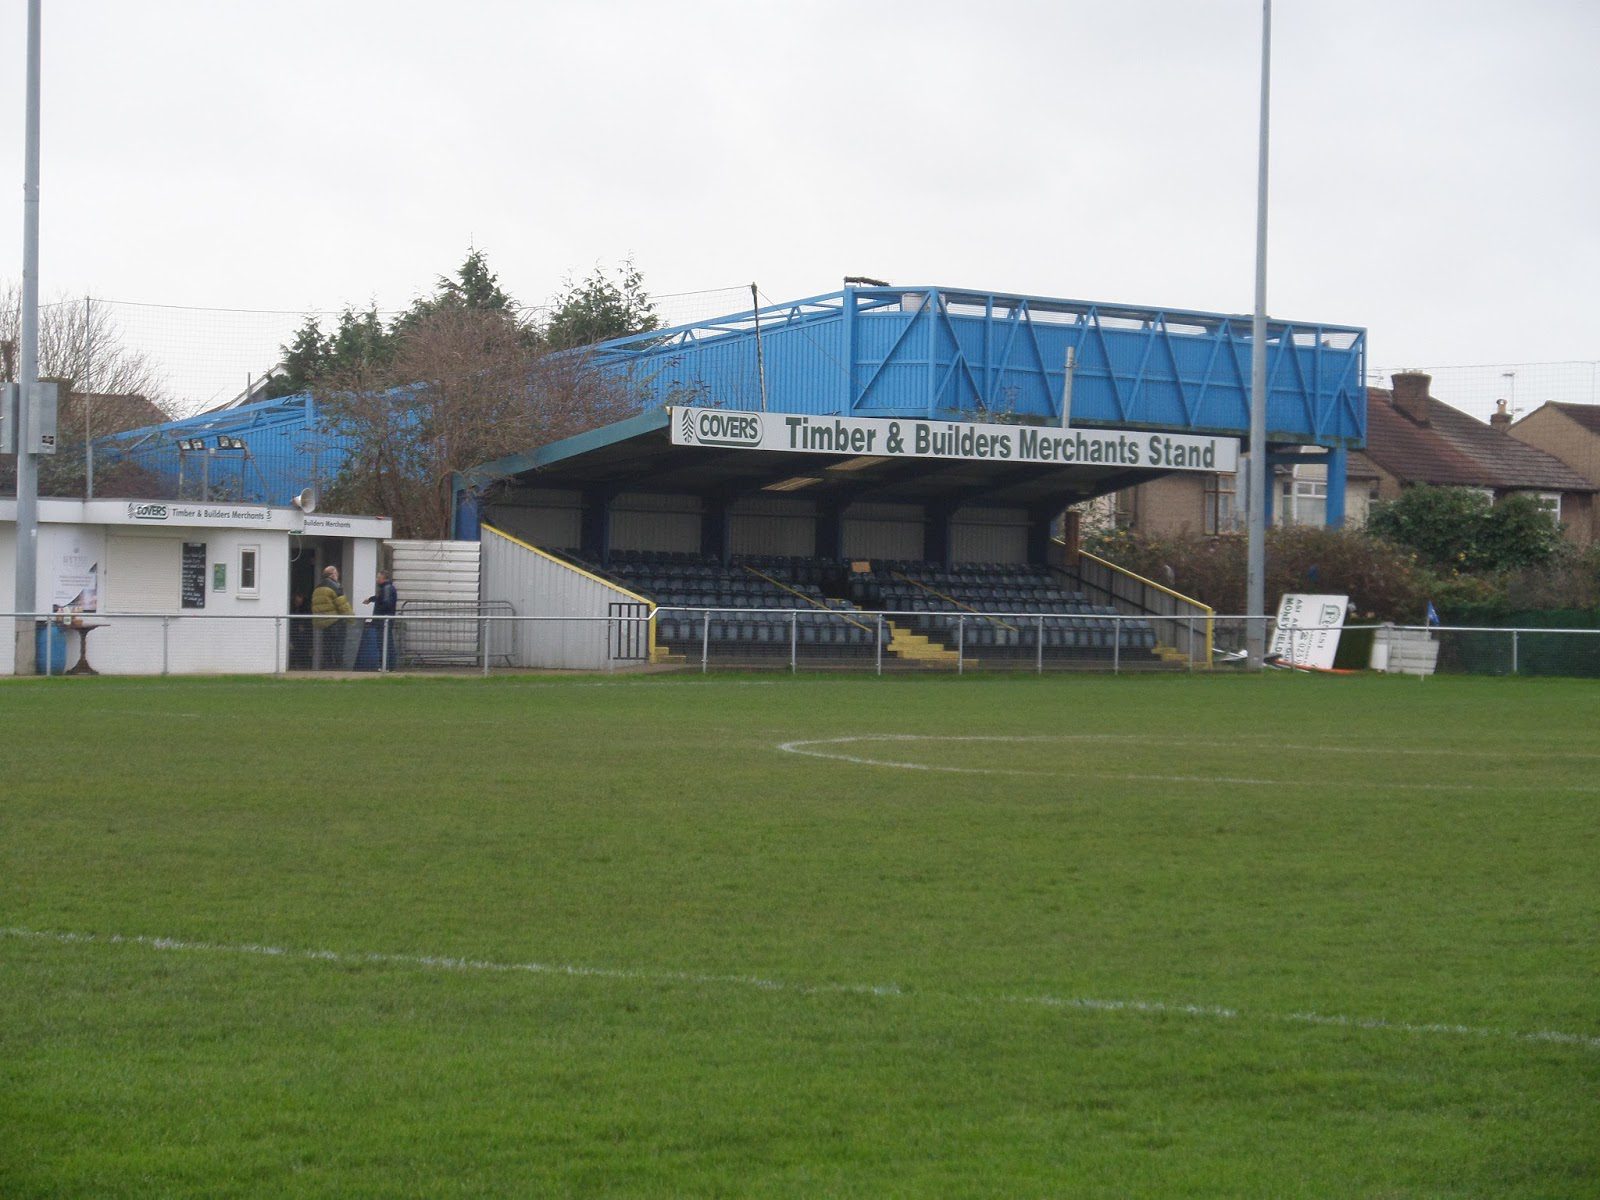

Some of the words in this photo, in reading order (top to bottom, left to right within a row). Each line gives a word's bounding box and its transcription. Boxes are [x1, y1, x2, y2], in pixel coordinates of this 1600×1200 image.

[700, 414, 759, 439] COVERS
[785, 416, 876, 452] Timber
[886, 421, 905, 454] &
[915, 423, 1012, 459] Builders
[1019, 428, 1139, 465] Merchants
[1149, 435, 1216, 468] Stand
[136, 504, 167, 516] COVERS
[172, 508, 196, 518] Timber
[197, 509, 203, 518] &
[204, 509, 231, 519] Builders
[232, 510, 265, 520] Merchants
[303, 519, 325, 528] Builders
[325, 520, 351, 530] Merchants
